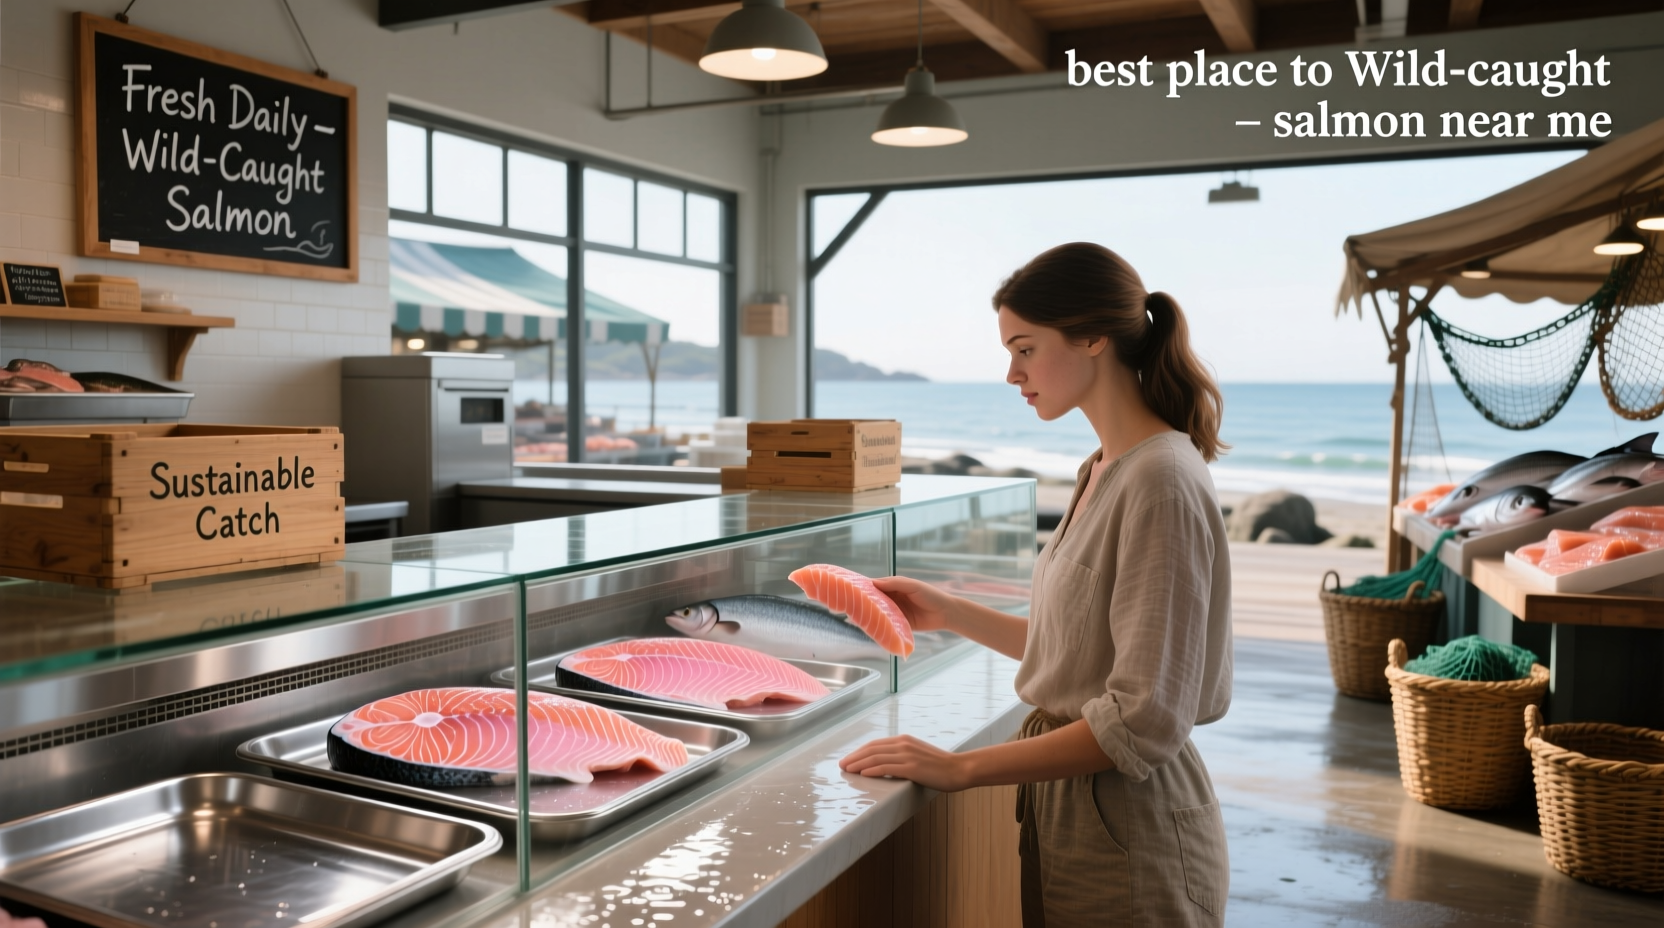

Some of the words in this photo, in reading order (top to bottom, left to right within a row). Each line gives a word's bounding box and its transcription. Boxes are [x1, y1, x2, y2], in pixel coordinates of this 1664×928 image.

[121, 64, 216, 124] Fresh
[121, 128, 325, 205] Wild-Caught
[165, 184, 297, 239] Salmon
[149, 455, 315, 500] Sustainable
[195, 501, 280, 541] Catch
